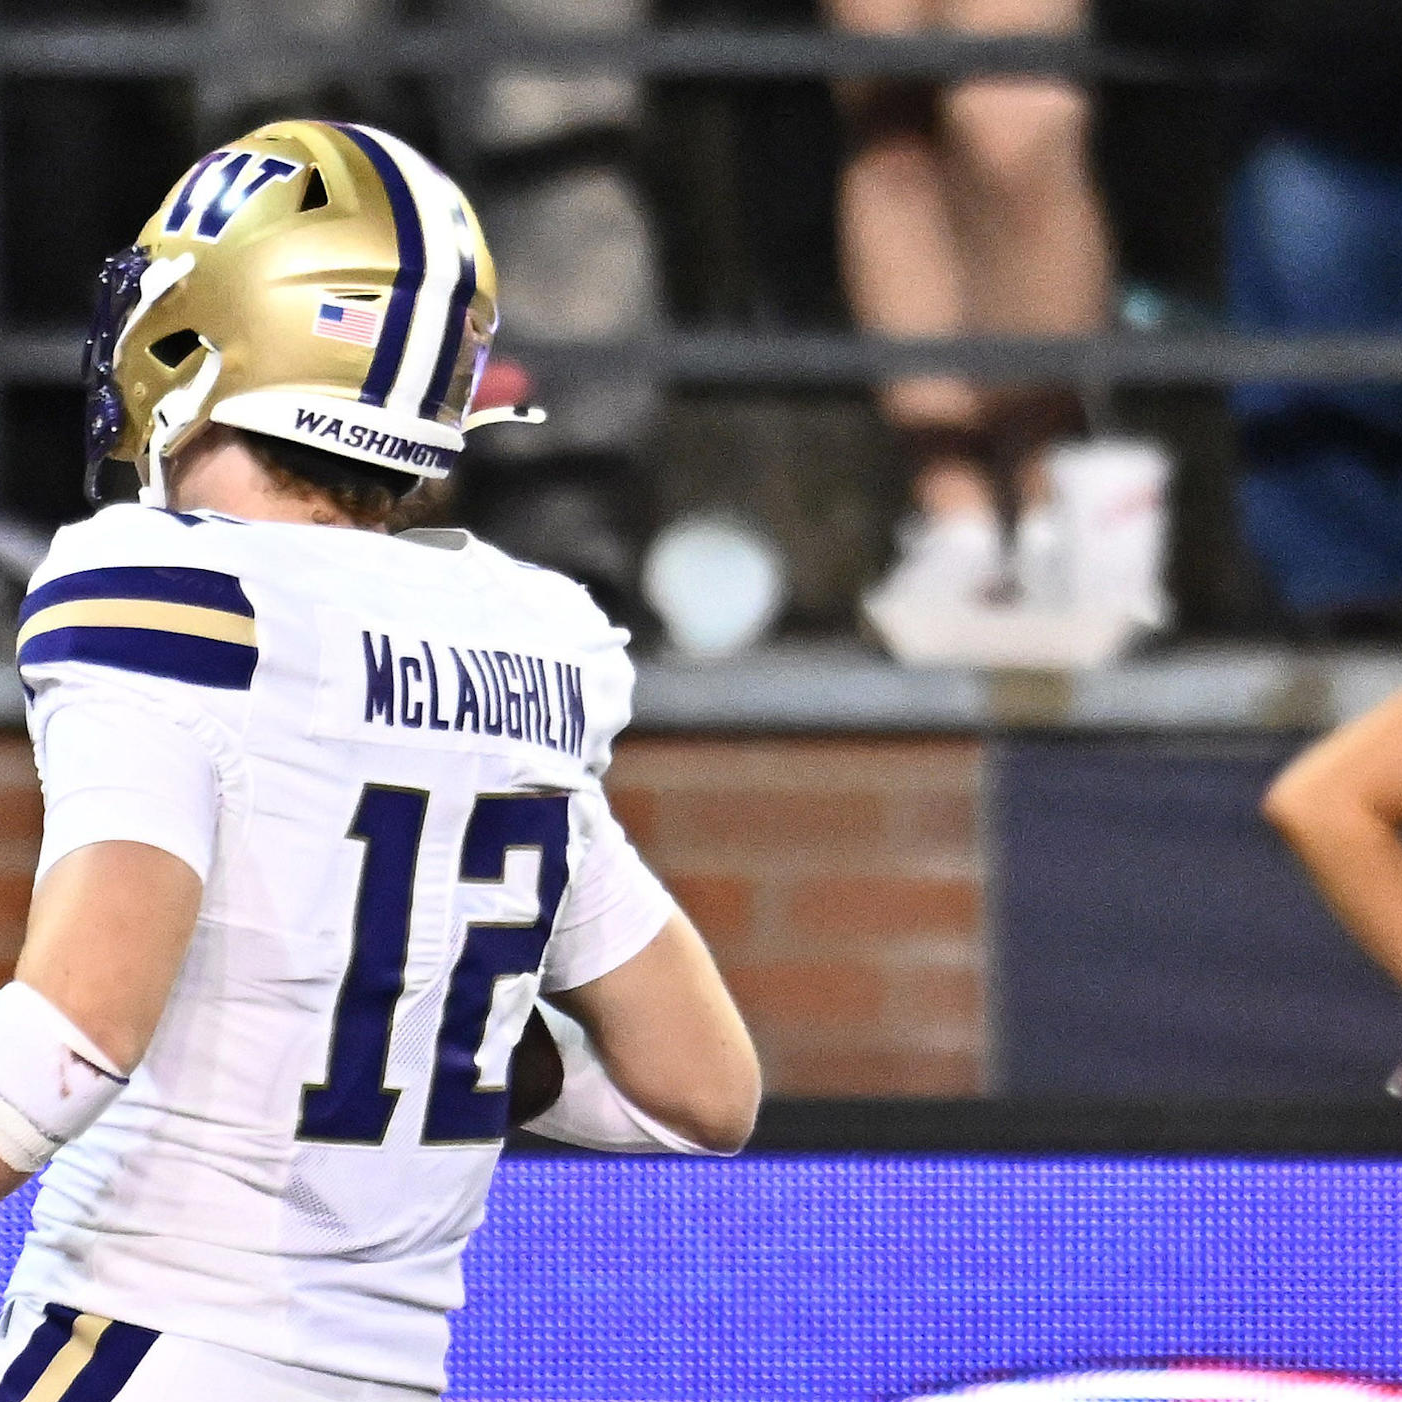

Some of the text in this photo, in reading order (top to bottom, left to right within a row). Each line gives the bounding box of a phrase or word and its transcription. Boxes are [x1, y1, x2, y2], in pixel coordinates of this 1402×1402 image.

[294, 407, 458, 470] WASHINGT
[361, 629, 586, 759] McLAUGHLIN
[294, 782, 571, 1147] 12
